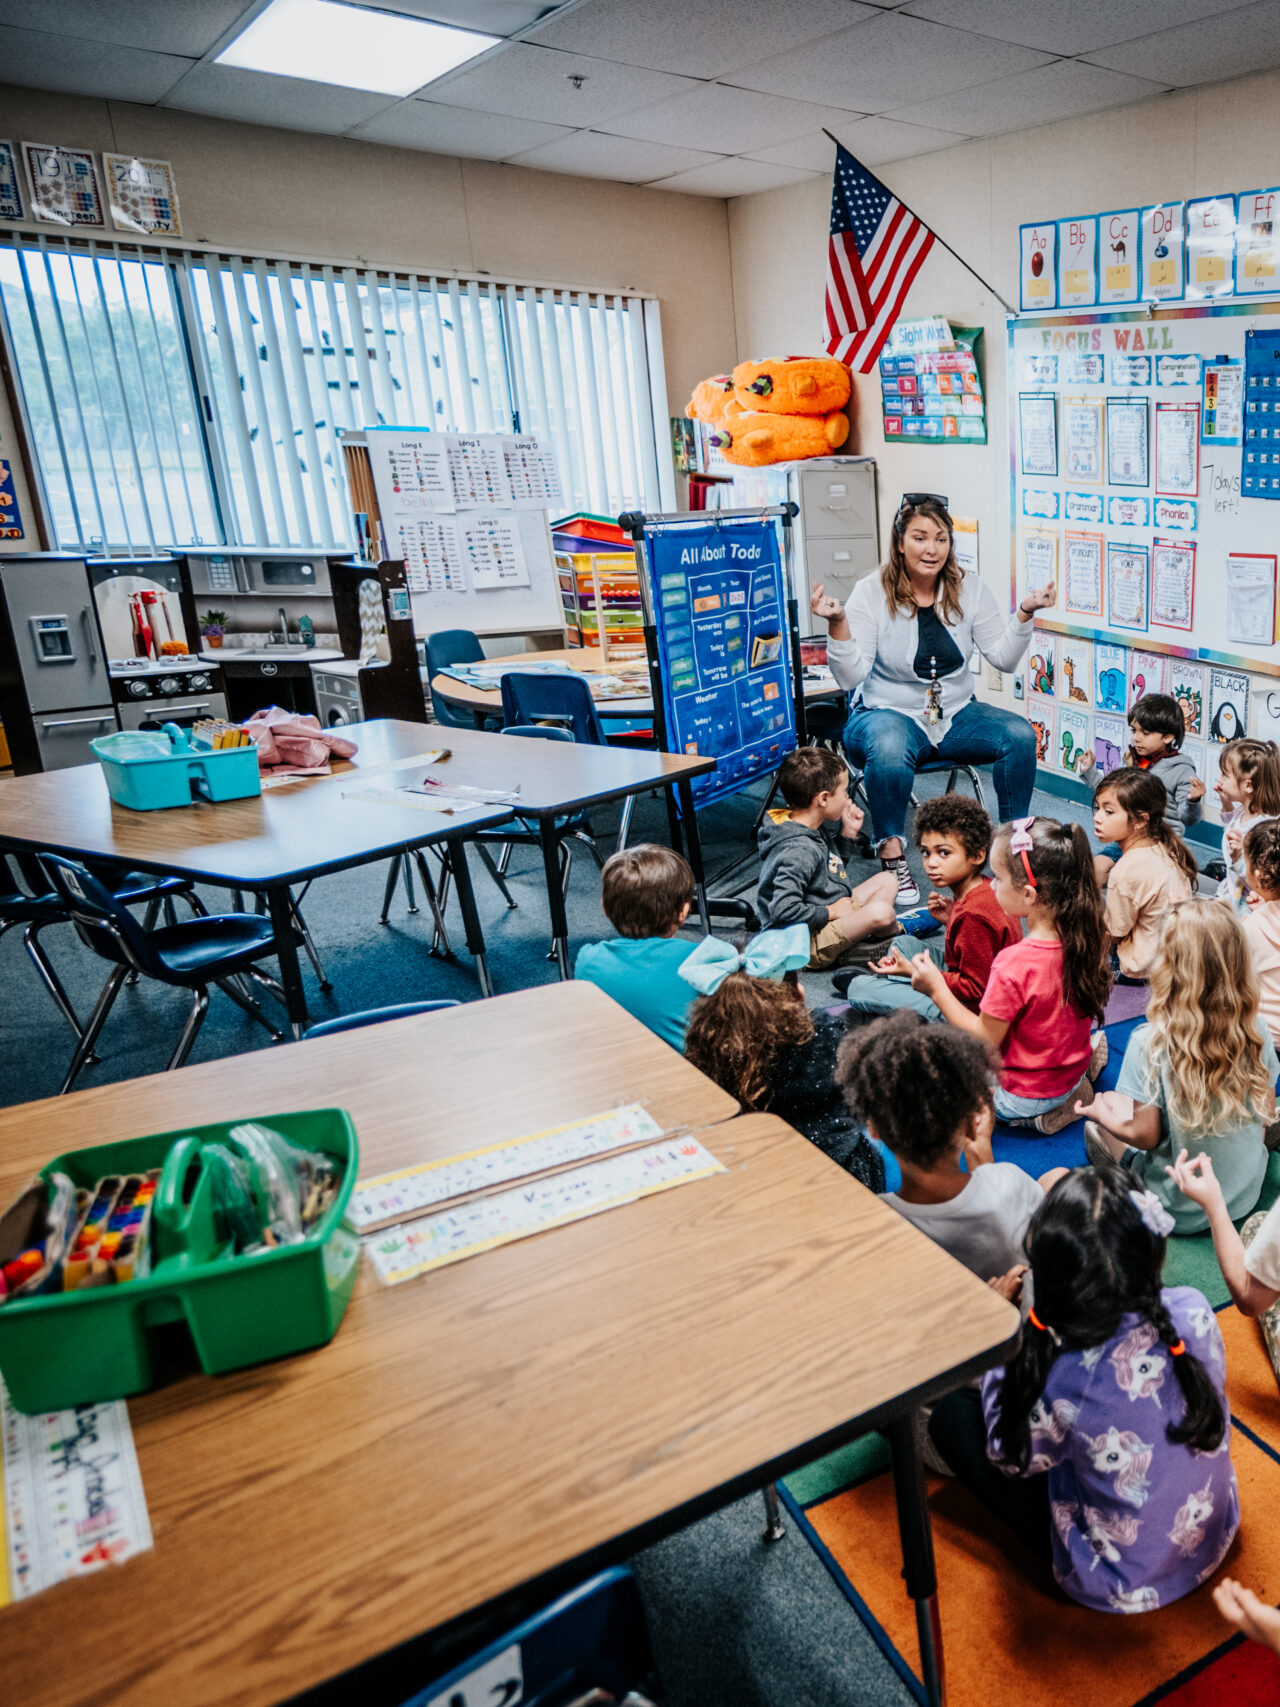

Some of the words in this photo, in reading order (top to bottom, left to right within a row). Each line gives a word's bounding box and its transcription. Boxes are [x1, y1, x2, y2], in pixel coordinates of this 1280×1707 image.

[36, 153, 62, 178] 19
[115, 165, 140, 184] 20
[50, 208, 96, 221] ineteen
[1253, 195, 1275, 219] Ff
[1109, 217, 1129, 240] Cc
[1152, 209, 1173, 234] Dd
[1030, 229, 1047, 250] Aa
[1069, 223, 1087, 246] Bb
[898, 325, 924, 347] Sight
[1041, 328, 1102, 351] FOCUS
[1113, 326, 1173, 351] WALL
[1208, 373, 1215, 384] 5
[1208, 385, 1215, 398] 4
[1208, 398, 1214, 409] 3
[1207, 411, 1214, 422] 2
[1207, 423, 1213, 435] 1
[401, 442, 418, 450] Long
[459, 440, 476, 448] Long
[514, 442, 532, 450] Long
[1202, 464, 1214, 496] 7
[1214, 467, 1241, 496] days
[1069, 502, 1099, 512] Grammar
[1117, 502, 1138, 513] Writing
[1160, 507, 1190, 521] Phonics
[478, 519, 492, 527] Long
[680, 547, 699, 565] All
[700, 544, 726, 562] About
[697, 622, 722, 632] Yesterday
[1035, 634, 1049, 648] RED
[1100, 646, 1121, 661] BLUE
[1138, 654, 1157, 671] PINK
[1172, 663, 1203, 680] BROWN
[1213, 674, 1246, 694] BLACK
[1062, 711, 1087, 730] GREEN
[1096, 719, 1123, 735] PURPLE
